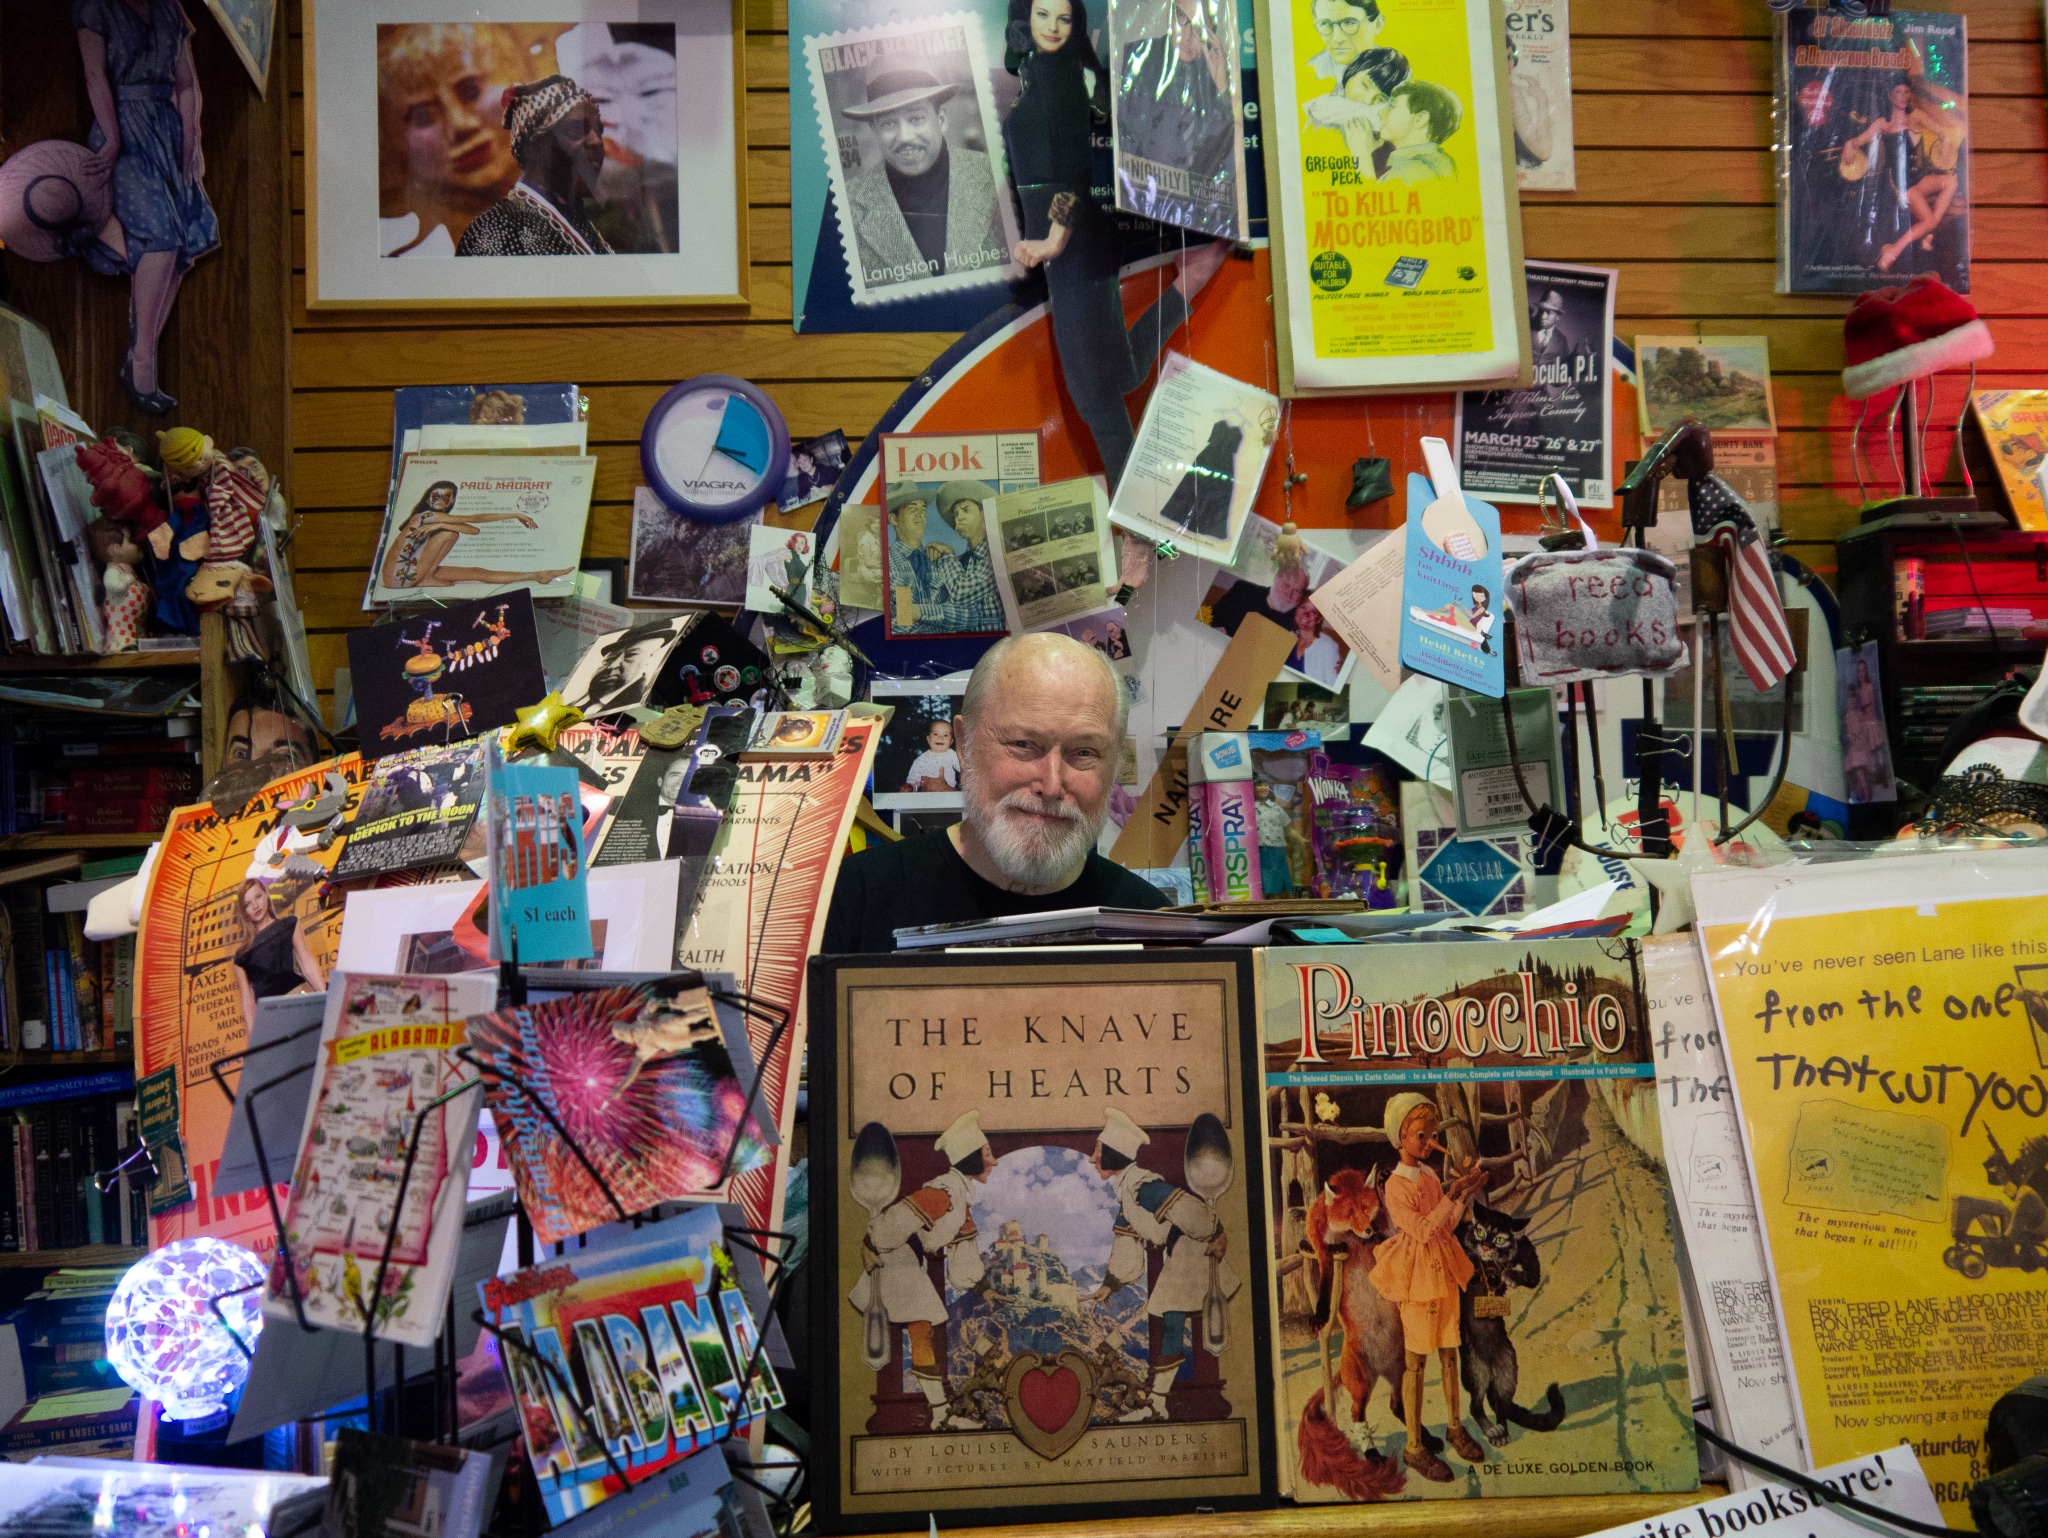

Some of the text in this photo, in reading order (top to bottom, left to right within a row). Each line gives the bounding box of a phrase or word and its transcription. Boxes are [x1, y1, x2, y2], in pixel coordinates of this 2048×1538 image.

[1904, 24, 1955, 35] Jim Reed
[820, 27, 968, 73] BLACK HERITAGE
[837, 135, 858, 149] USA
[840, 151, 862, 169] 34
[1305, 155, 1359, 172] GREGORY
[1130, 157, 1182, 190] NIGHTLY
[1331, 170, 1363, 186] PECK
[1191, 187, 1231, 203] WILMORE
[1355, 191, 1399, 217] KILL
[1406, 191, 1421, 214] A
[862, 244, 1010, 284] Langston Hughes
[1313, 261, 1347, 270] SUITABLE
[1322, 253, 1335, 261] NOT
[1316, 278, 1347, 287] CHILDREN
[1323, 270, 1338, 278] FOR
[1551, 276, 1605, 288] COMPANY PRESENTS
[1313, 292, 1342, 300] PULITZER
[1576, 354, 1598, 383] P.I.
[1488, 402, 1587, 428] Improv Comedy
[1465, 431, 1521, 447] MARCH
[1567, 439, 1579, 452] &
[1743, 440, 1765, 449] BANK
[896, 444, 985, 473] Look
[460, 480, 553, 490] PAUL MAURIAT
[683, 479, 746, 490] VIAGRA
[1416, 570, 1460, 594] knitting!
[1568, 572, 1654, 602] reed
[1556, 618, 1667, 649] books
[1419, 634, 1486, 667] Heidi Betts
[1420, 649, 1484, 680] HeidiBetts.com
[93, 782, 142, 792] McCammon
[159, 781, 191, 791] SONG
[1308, 777, 1350, 805] WONKA
[349, 820, 397, 843] ICEPICK
[400, 815, 415, 827] TO
[416, 809, 438, 823] THE
[439, 804, 476, 818] MOON
[699, 877, 747, 888] SCHOOLS
[1436, 860, 1505, 884] PARISIAN
[524, 905, 577, 923] $1 each
[1735, 960, 1803, 976] You've
[1813, 954, 1866, 971] never
[1873, 950, 1916, 966] seen
[1922, 947, 1965, 962] Lane
[1973, 943, 2004, 958] like
[185, 969, 227, 991] TAXES
[186, 981, 239, 1005] GOVERNME
[196, 994, 235, 1014] FEDERAL
[208, 1007, 237, 1022] STATE
[1286, 962, 1627, 1064] Pinocchio
[1755, 989, 1844, 1033] from
[1858, 985, 1922, 1019] the
[370, 1027, 450, 1051] ALABAMA
[886, 1013, 1193, 1046] THE KNAVE
[187, 1028, 246, 1054] ROADS AND
[59, 1078, 84, 1091] SALLY
[888, 1065, 1192, 1100] OF HEARTS
[1289, 1075, 1301, 1083] The
[1303, 1075, 1328, 1083] Beloved
[1329, 1074, 1354, 1082] Classic
[1355, 1074, 1363, 1083] by
[1384, 1073, 1406, 1081] Collodi
[1428, 1072, 1442, 1080] New
[1469, 1070, 1500, 1080] Complete
[1502, 1070, 1515, 1078] and
[1516, 1069, 1553, 1079] Unabridged
[1561, 1067, 1594, 1077] Illustrated
[1604, 1066, 1618, 1075] Full
[1619, 1066, 1637, 1074] Color
[142, 1077, 172, 1098] Savings
[143, 1094, 172, 1113] Federal
[143, 1107, 176, 1128] Jefferson
[1797, 1211, 1918, 1237] The mysterious note
[1795, 1225, 1874, 1246] that began it
[1810, 1289, 2048, 1320] Rev. FRED LANE HUGO DANNY
[1812, 1303, 2041, 1331] RON PATE FLOUNDER BUNTE
[1990, 1321, 2027, 1333] SOME
[1815, 1325, 1939, 1343] PHIL BILL YEAST
[1816, 1339, 1921, 1354] WAYNE STRETCH
[500, 1288, 786, 1480] ALABAMA
[1738, 1376, 1766, 1389] Now
[1834, 1409, 1948, 1429] Now showing at
[50, 1430, 67, 1441] THE
[69, 1426, 106, 1440] ANGEL'S
[108, 1422, 133, 1433] GAME
[889, 1432, 1210, 1459] BY LOUISE SAUNDERS
[872, 1450, 1229, 1477] WITH PICTURES BY MAXFIELD PARRISH
[1467, 1460, 1656, 1475] A DE LUXE GOLDEN BOOK
[1696, 1454, 1894, 1537] bookstore!
